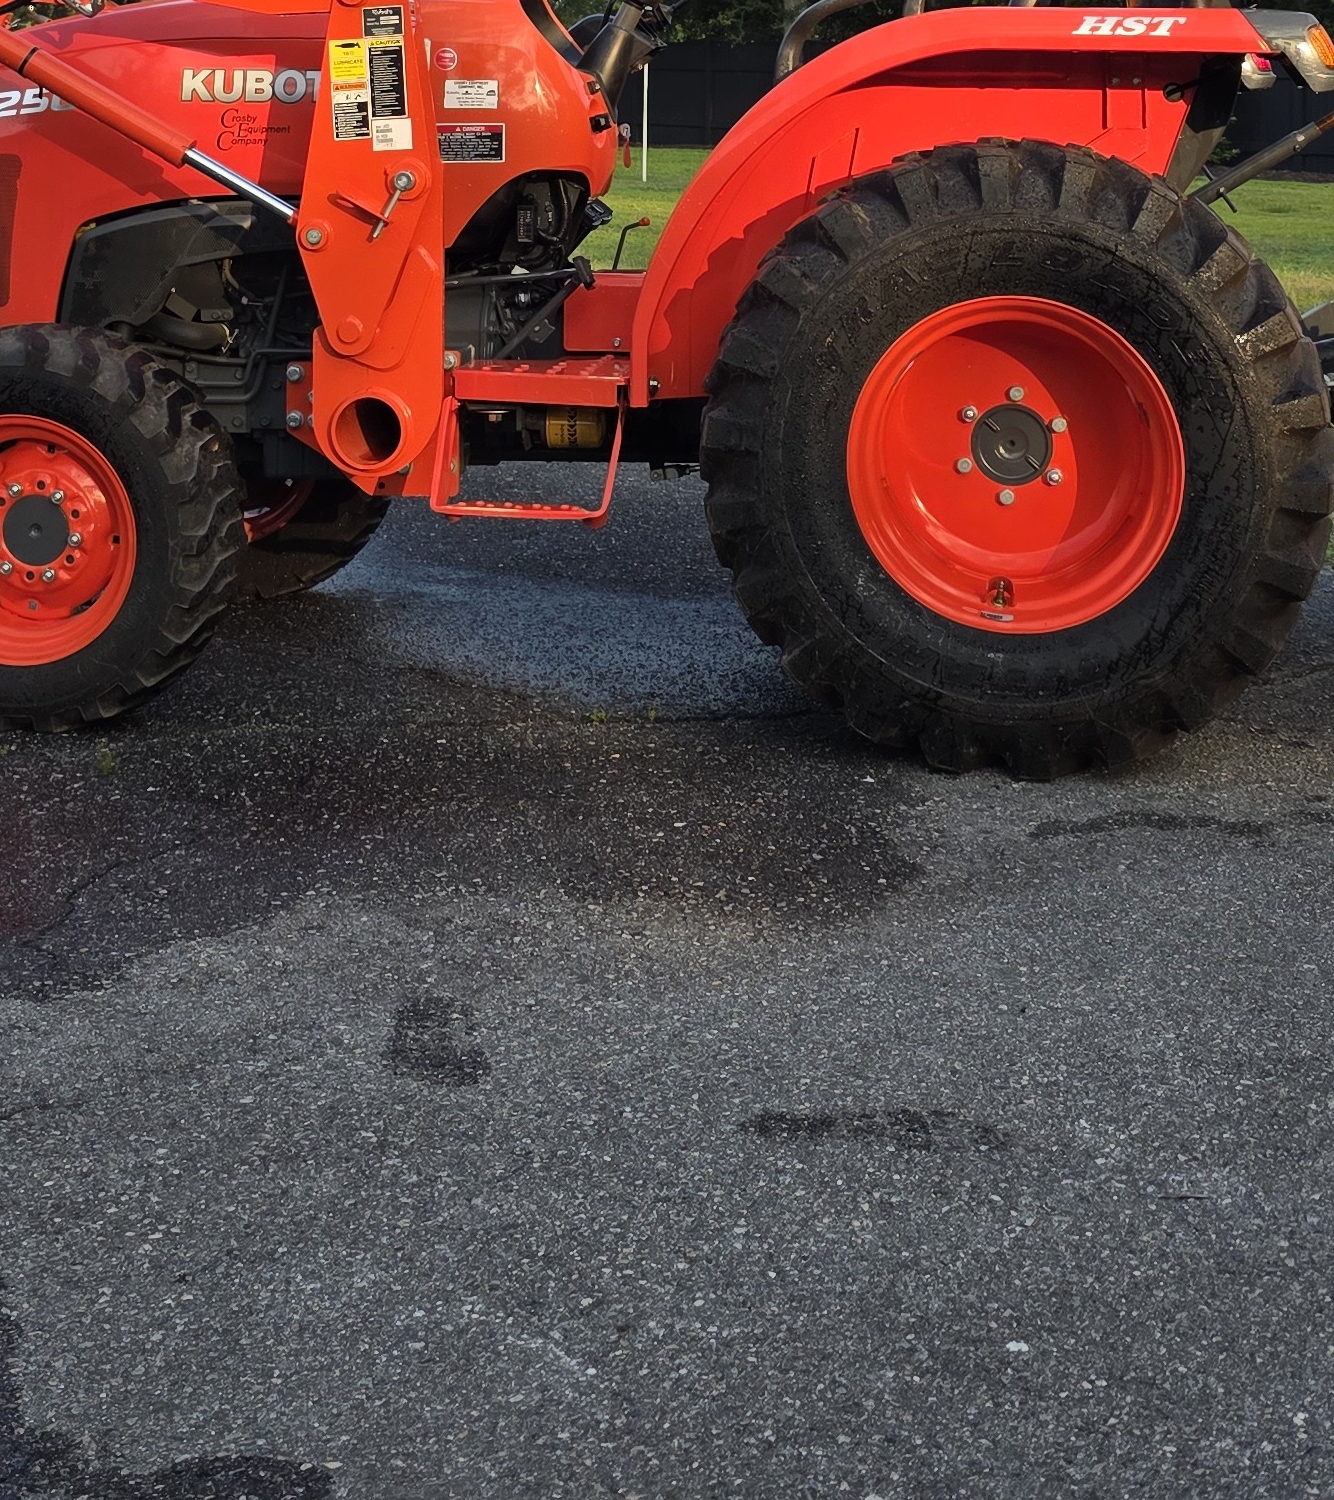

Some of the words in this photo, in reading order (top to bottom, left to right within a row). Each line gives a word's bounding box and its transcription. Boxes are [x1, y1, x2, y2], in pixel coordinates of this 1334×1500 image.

[1071, 16, 1187, 37] HST
[220, 108, 257, 129] Crosby
[217, 130, 268, 151] Company
[237, 122, 291, 138] Equipment
